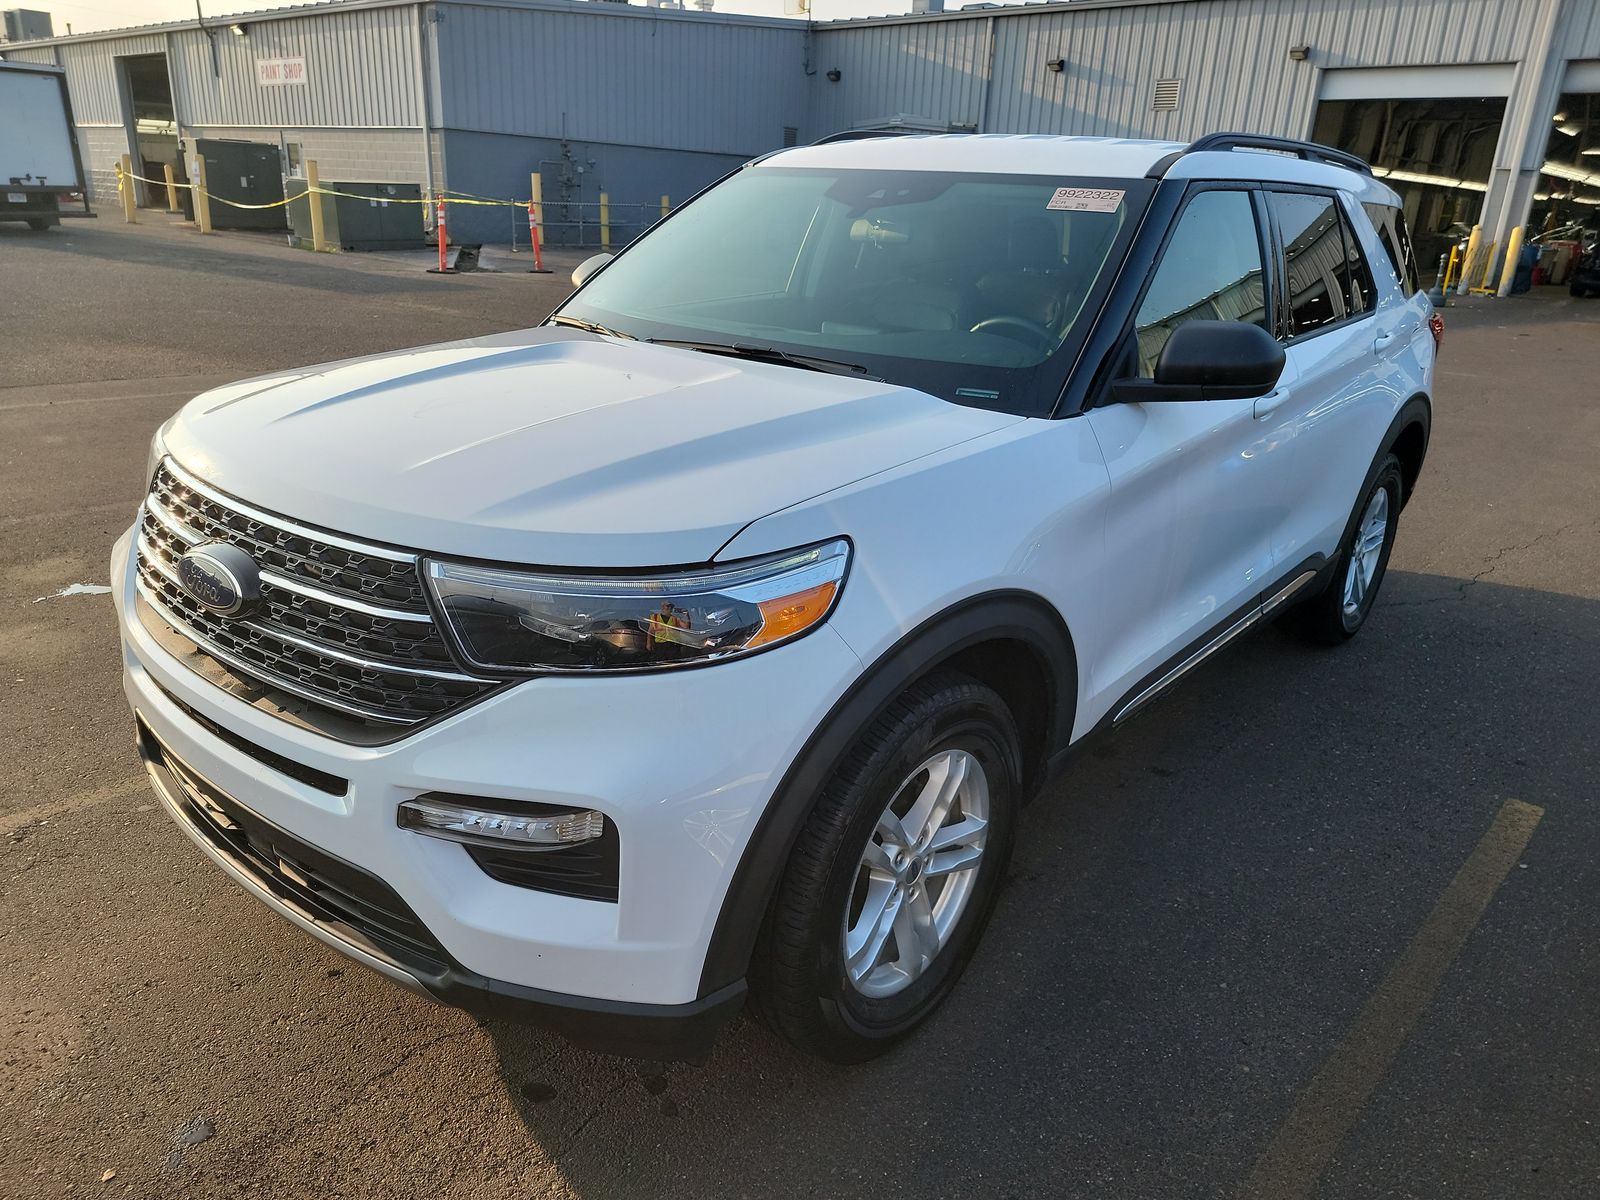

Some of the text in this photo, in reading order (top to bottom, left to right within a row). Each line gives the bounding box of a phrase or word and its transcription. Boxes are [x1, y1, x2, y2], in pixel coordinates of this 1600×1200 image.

[260, 63, 303, 80] PAINT SHOP
[1057, 189, 1120, 200] 9922322
